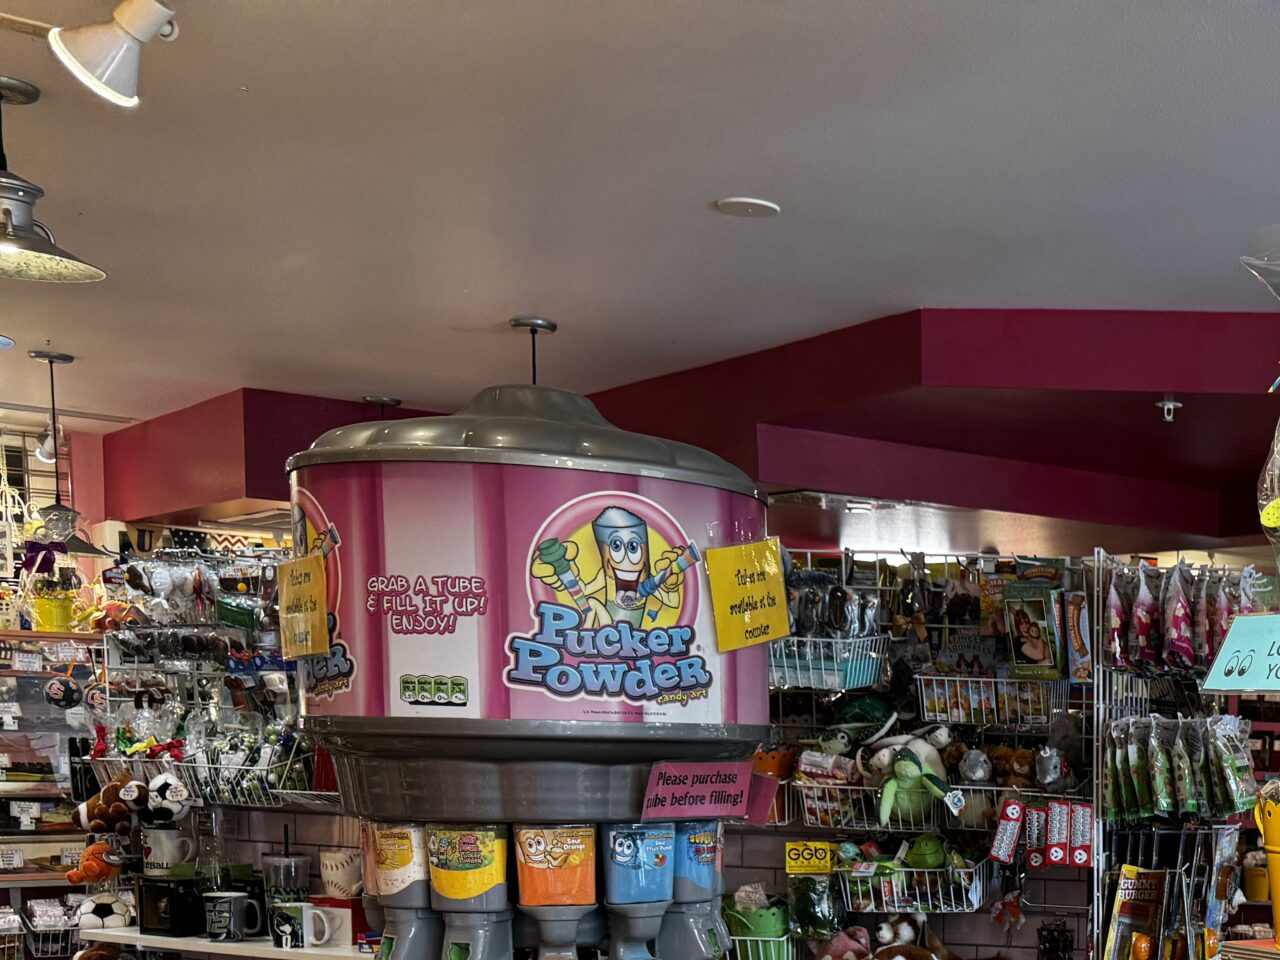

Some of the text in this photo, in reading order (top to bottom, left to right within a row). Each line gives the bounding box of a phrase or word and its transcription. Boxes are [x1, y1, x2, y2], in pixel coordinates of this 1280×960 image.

[136, 528, 154, 553] U
[367, 576, 484, 593] GRAB A TUBE
[366, 595, 486, 613] & FILL IT UP!
[392, 615, 456, 632] ENJOY!
[537, 602, 693, 658] Pucker
[657, 688, 708, 709] candy art
[656, 771, 738, 788] Please purchase
[670, 792, 706, 807] before
[709, 790, 745, 807] filling!
[1120, 879, 1157, 890] GUMMY
[1119, 890, 1158, 900] BURGER
